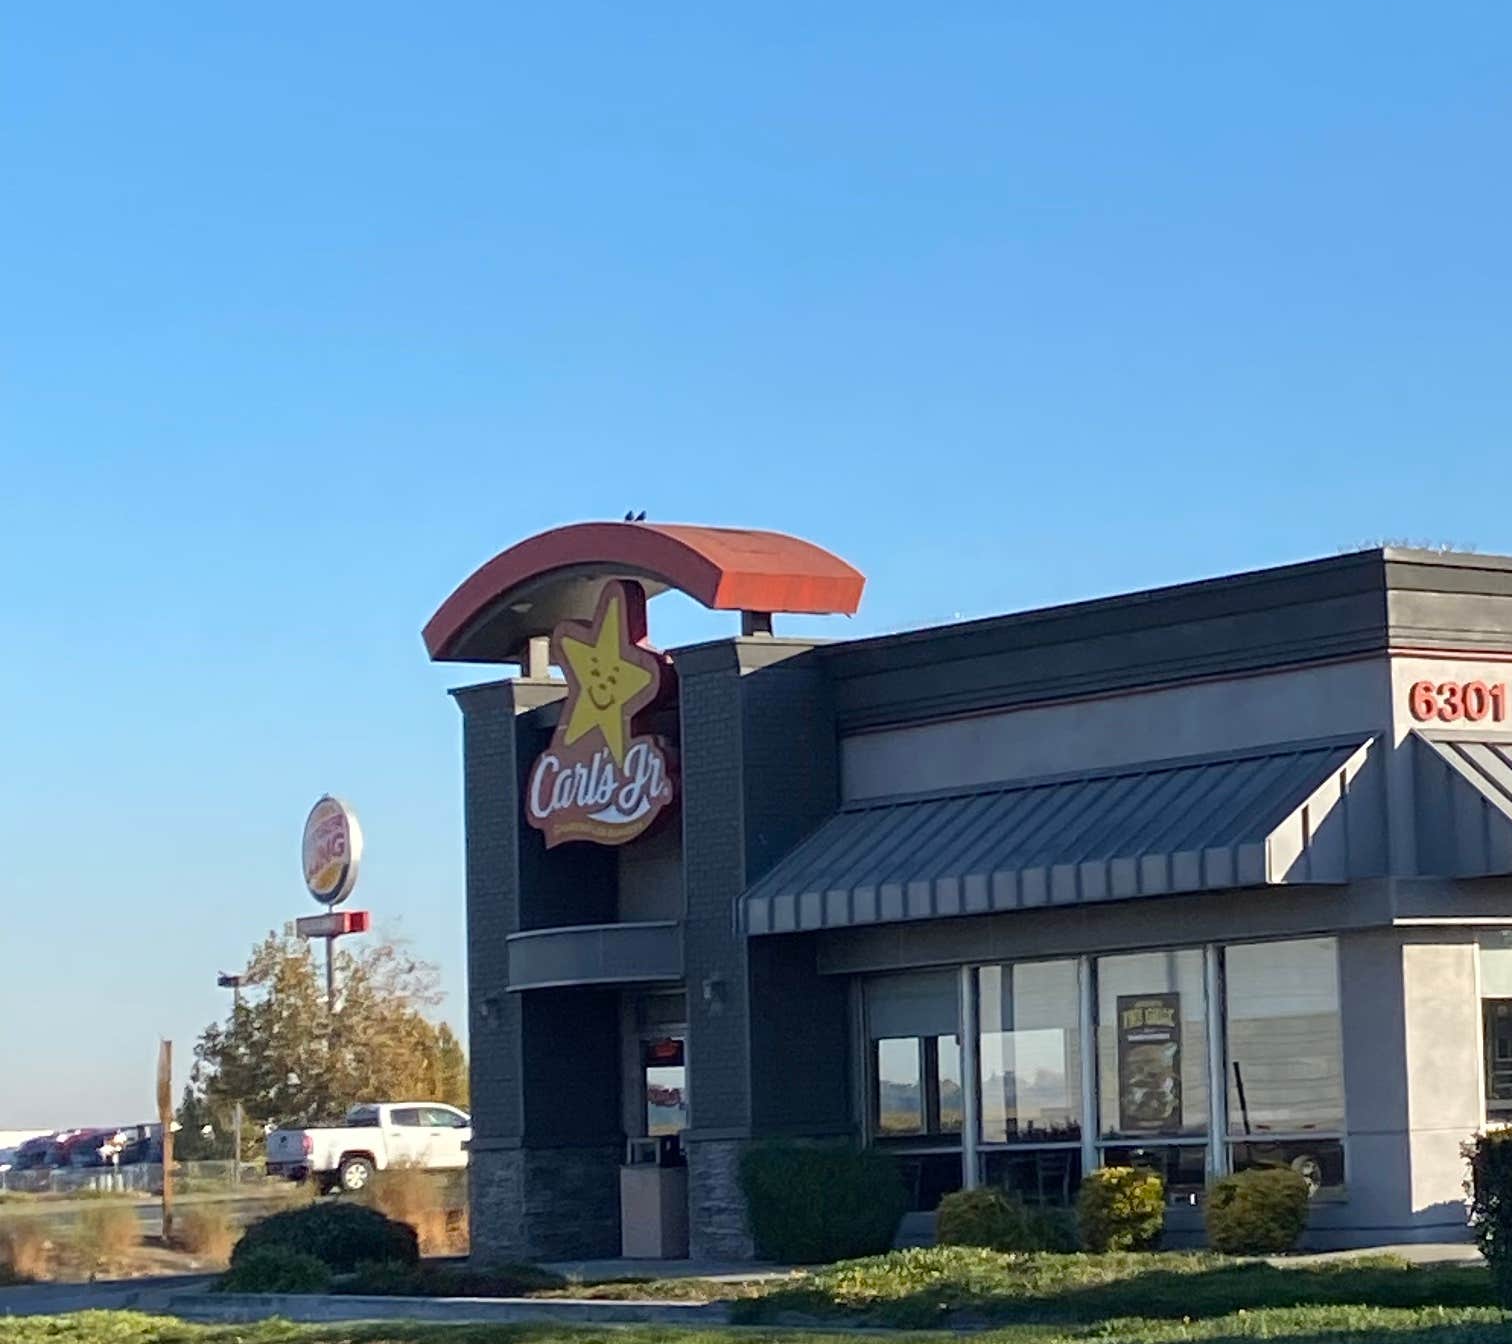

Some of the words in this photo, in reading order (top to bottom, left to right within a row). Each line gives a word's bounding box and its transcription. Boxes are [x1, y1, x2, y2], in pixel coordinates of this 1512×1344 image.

[1408, 680, 1506, 722] 6301
[530, 747, 619, 818] Carl's
[619, 743, 670, 809] Jr.
